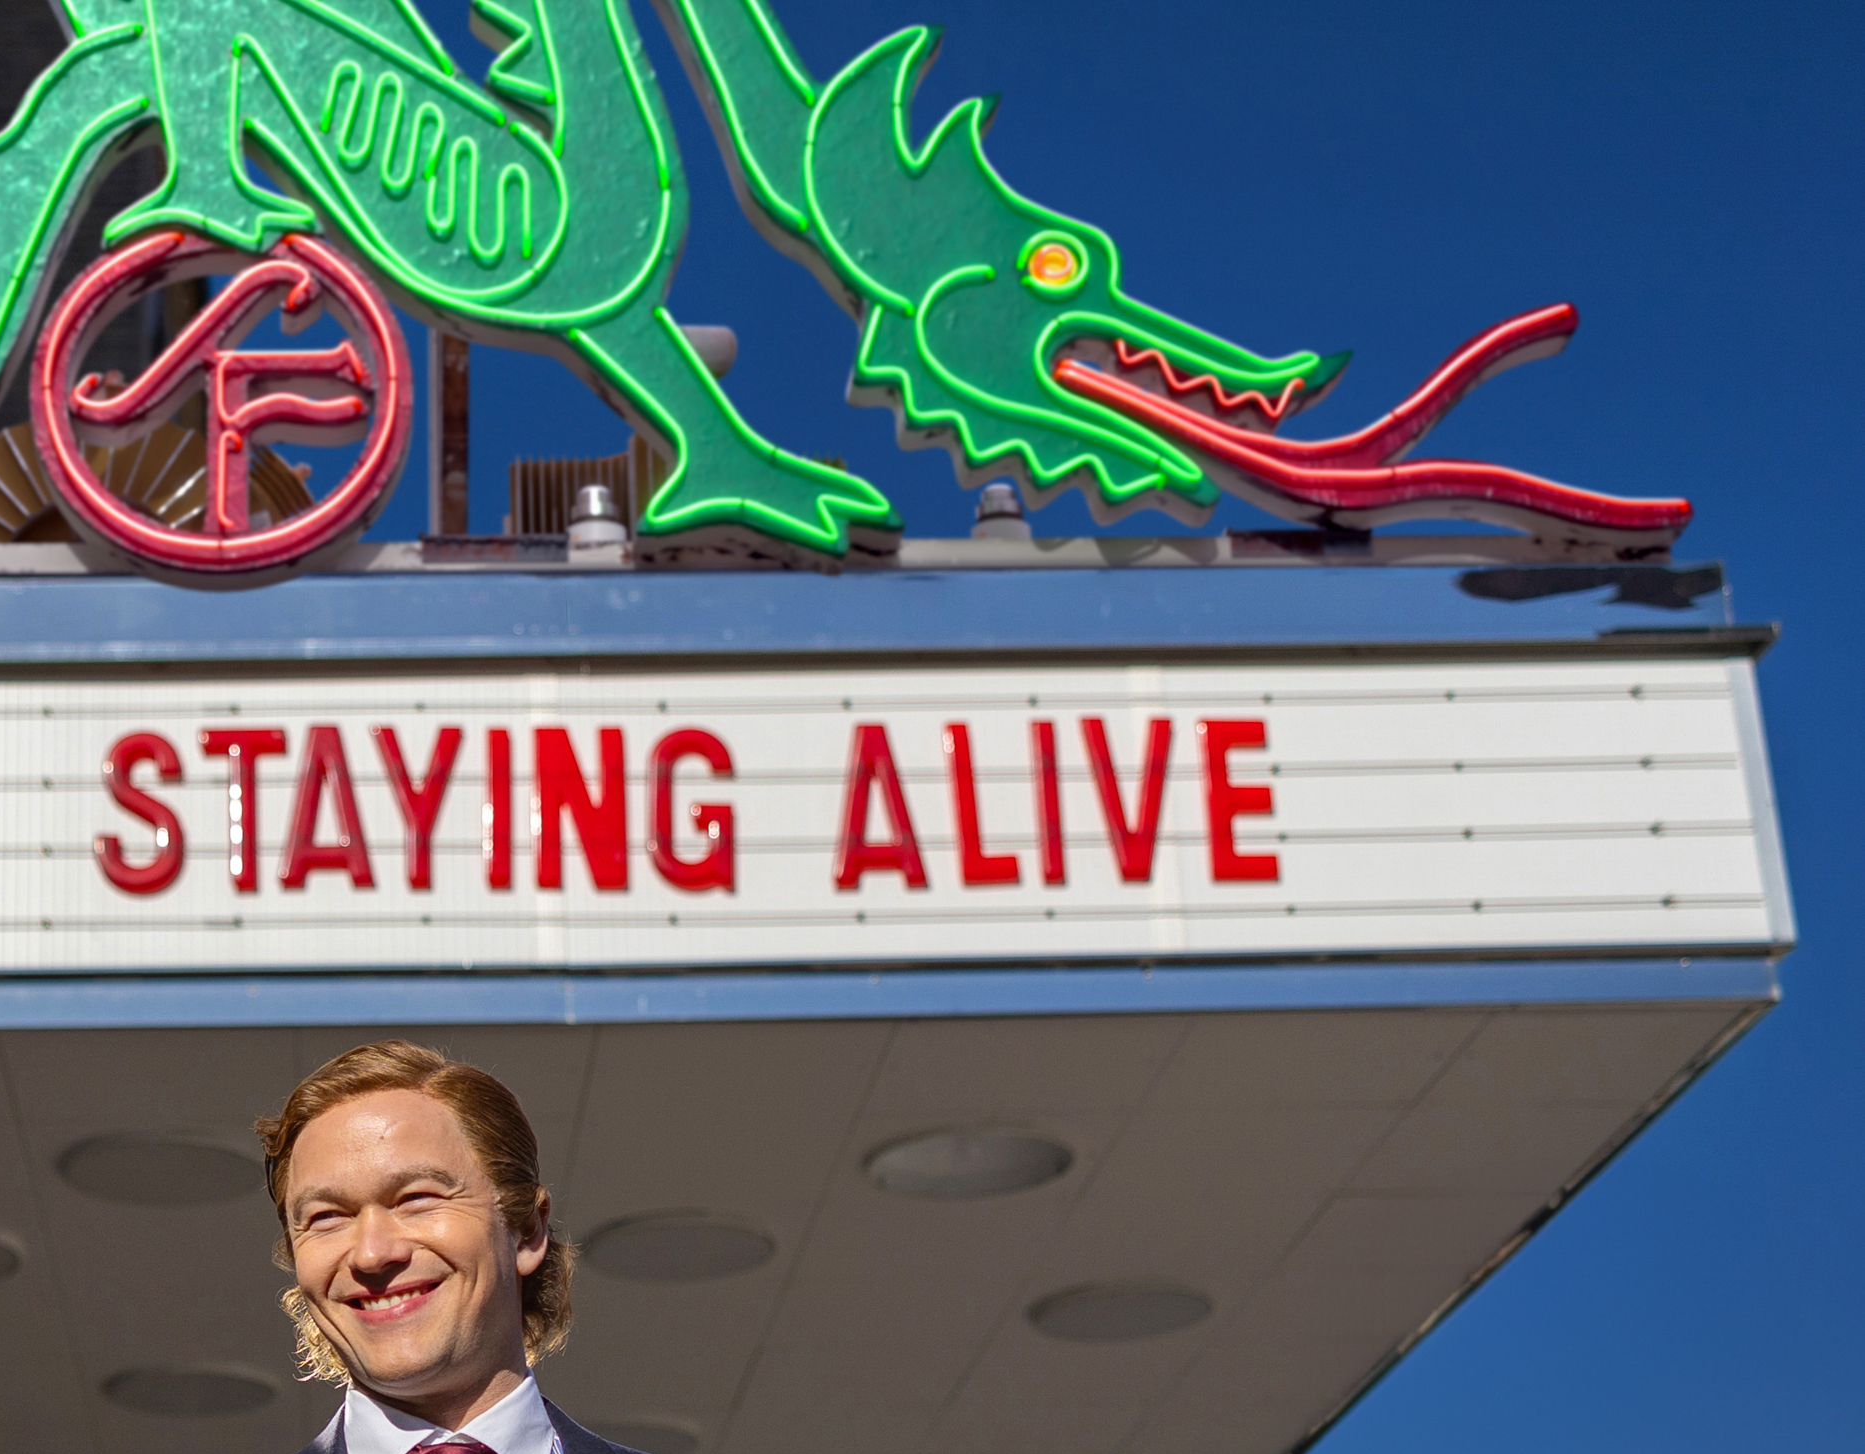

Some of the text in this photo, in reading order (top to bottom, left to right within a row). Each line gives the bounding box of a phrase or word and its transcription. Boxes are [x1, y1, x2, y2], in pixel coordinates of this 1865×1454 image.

[68, 258, 374, 534] SF
[94, 724, 736, 894] STAYING
[832, 716, 1282, 892] ALIVE
